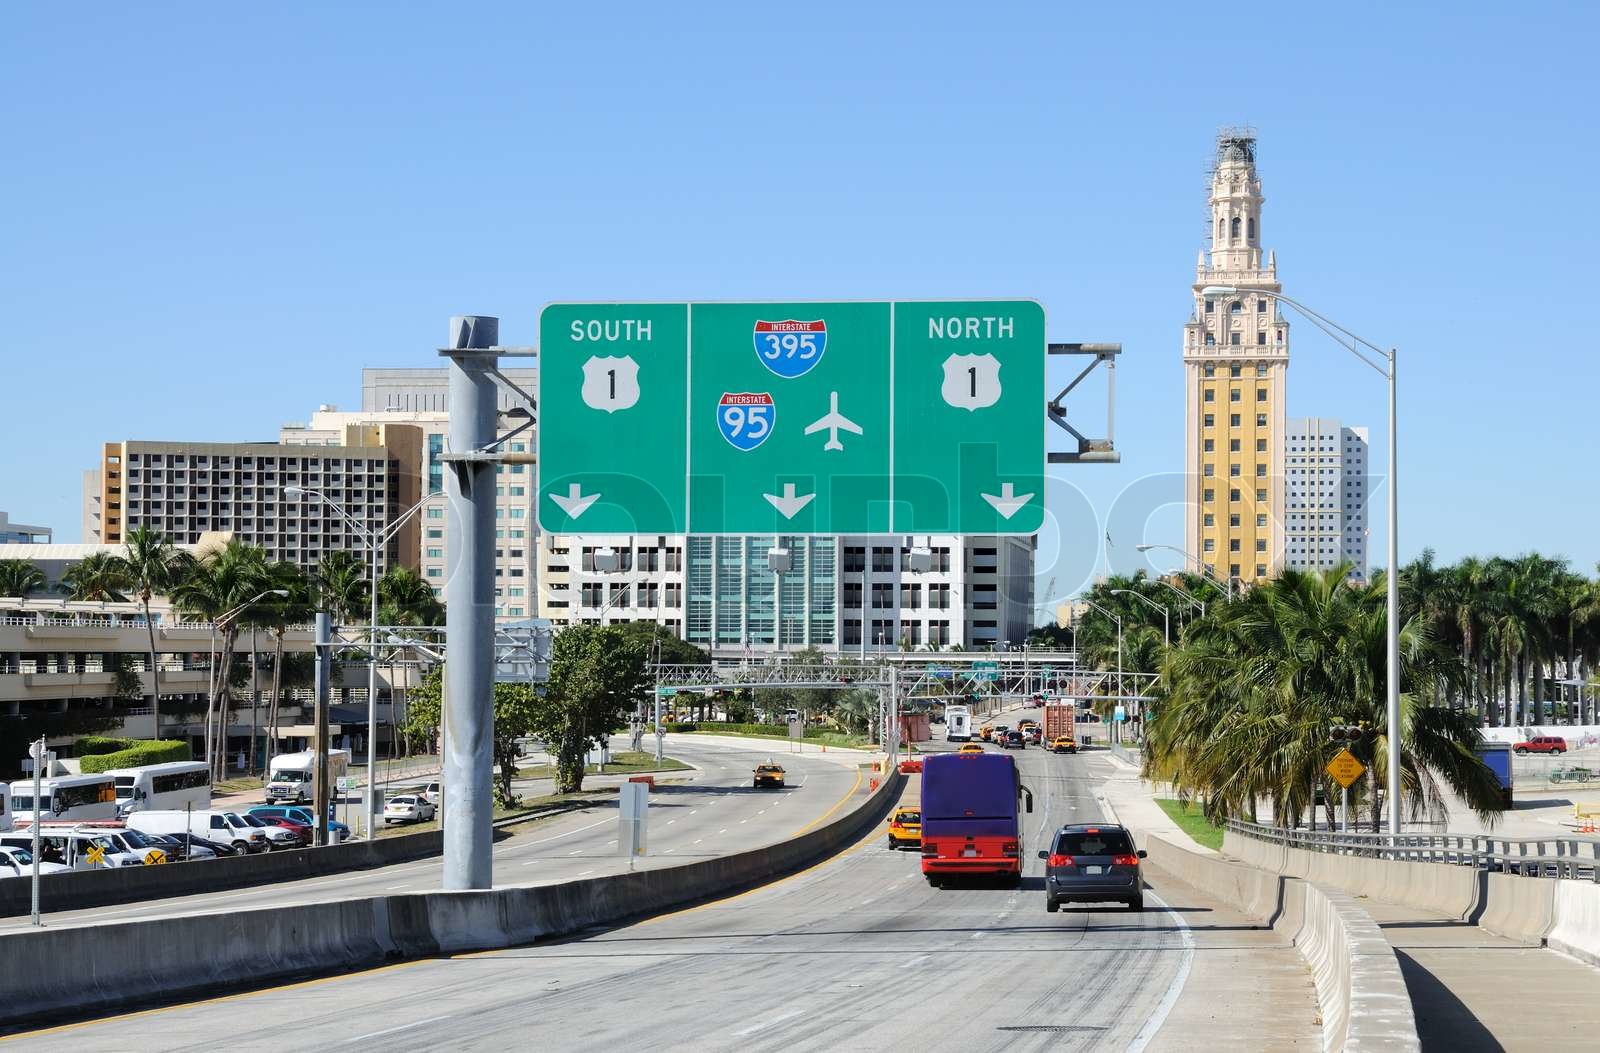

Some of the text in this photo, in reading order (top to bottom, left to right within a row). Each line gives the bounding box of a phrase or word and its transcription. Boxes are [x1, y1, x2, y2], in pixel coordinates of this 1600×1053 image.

[570, 319, 652, 341] SOUTH
[771, 323, 811, 331] INTERSTATE
[928, 317, 1014, 339] NORTH
[764, 334, 817, 360] 395
[607, 369, 616, 400] 1
[968, 367, 976, 398] 1
[726, 396, 767, 404] INTERSTATE
[724, 406, 769, 439] 95
